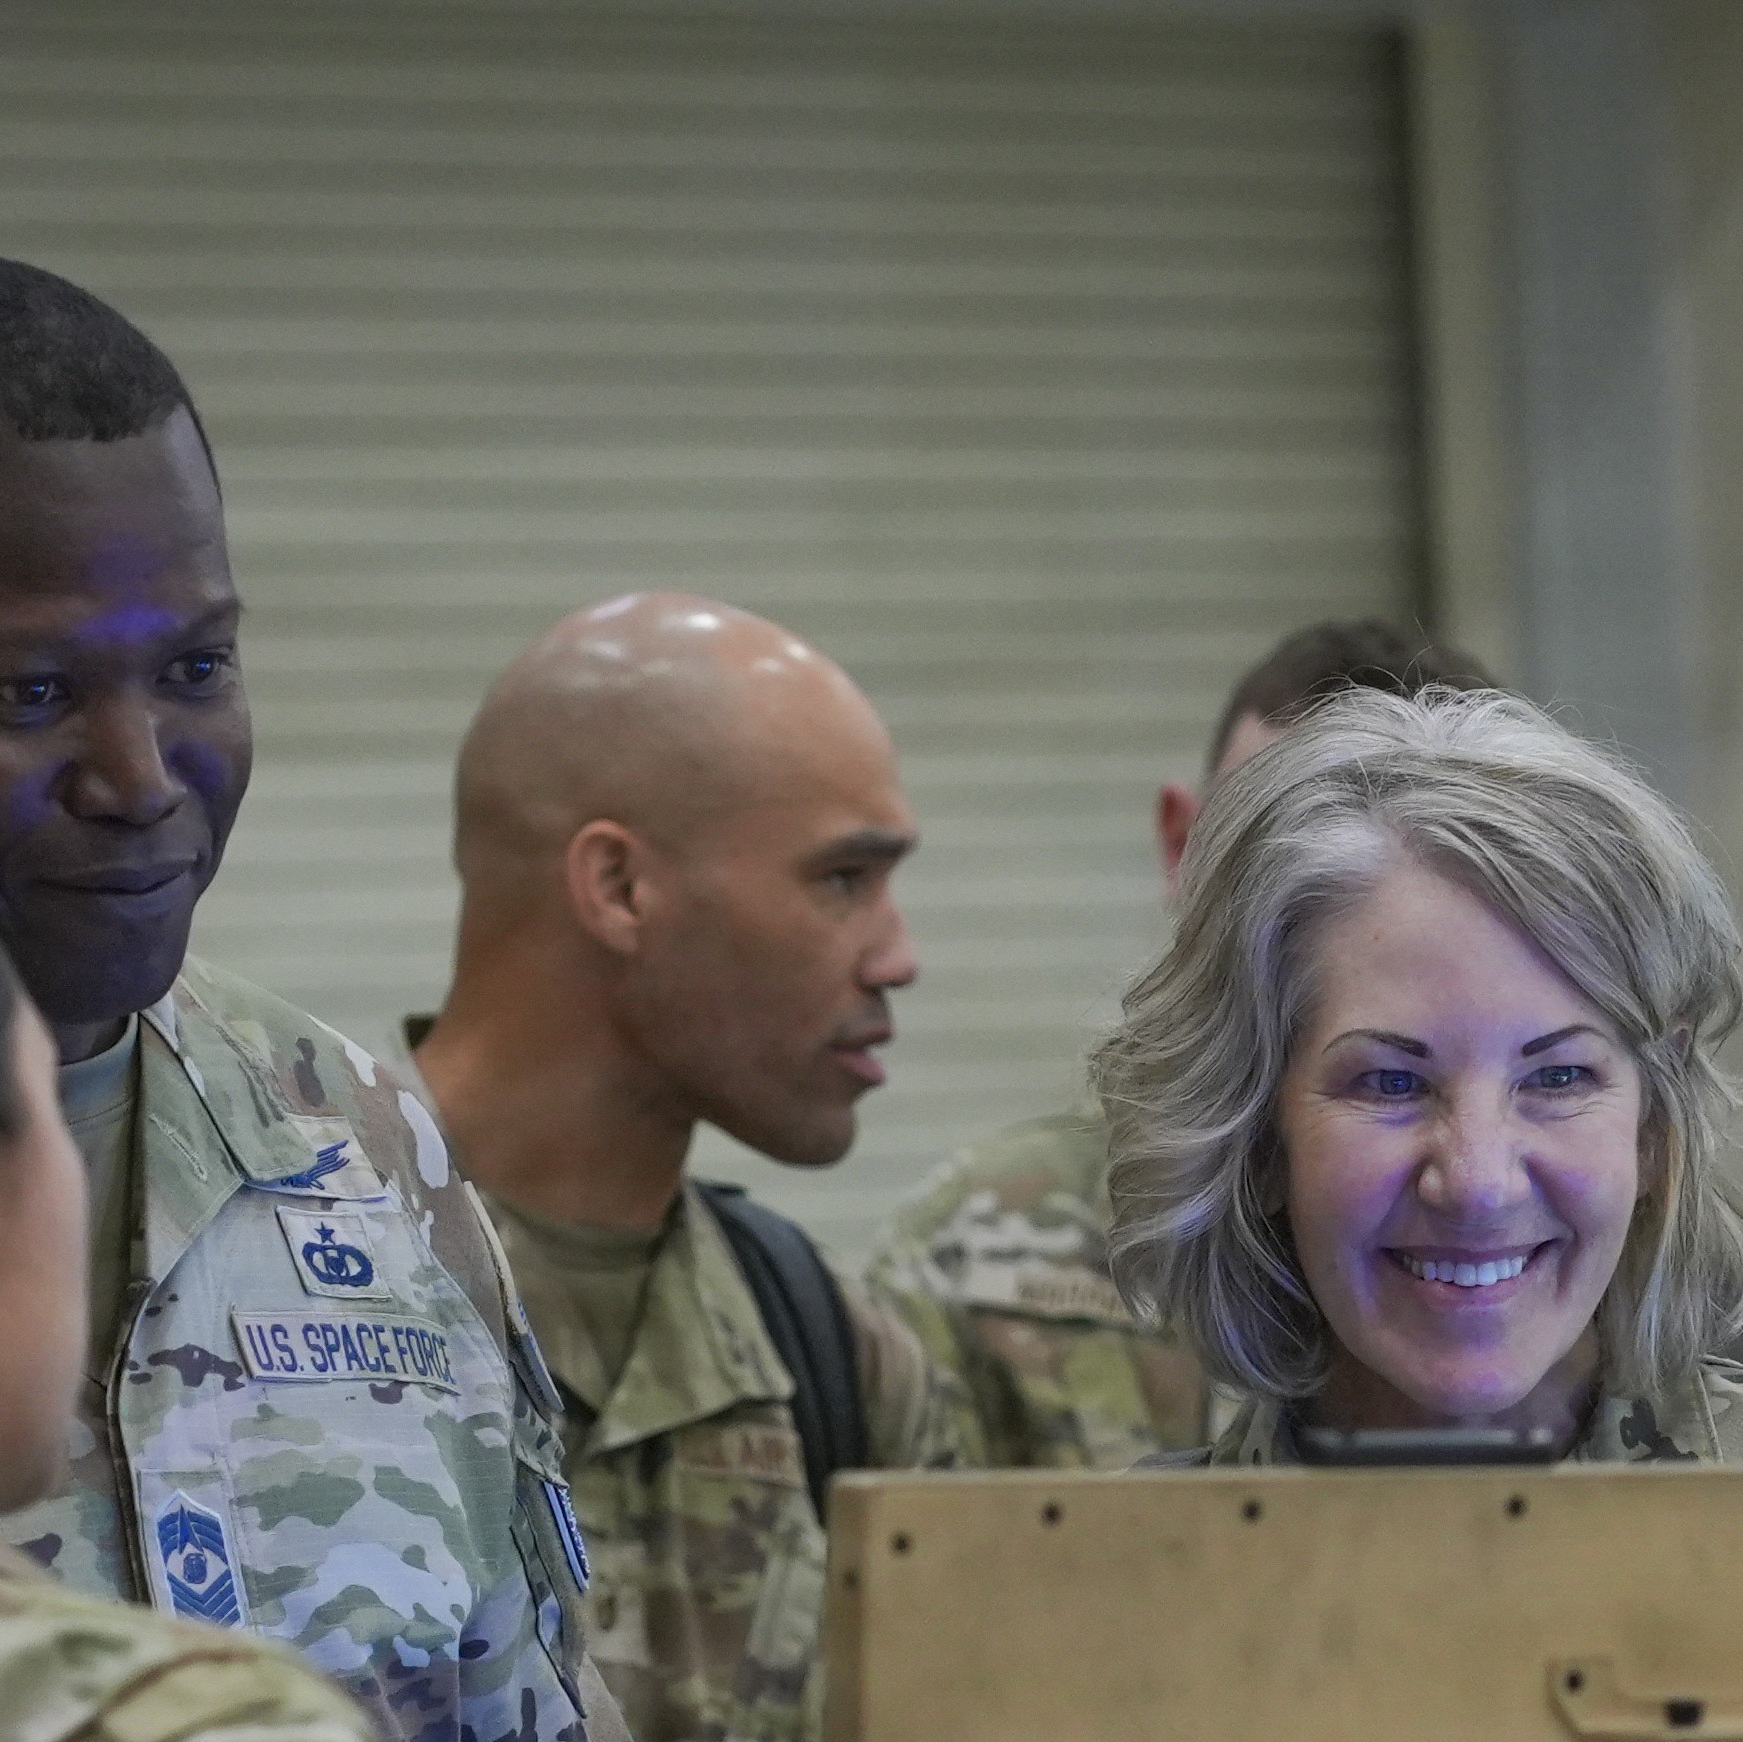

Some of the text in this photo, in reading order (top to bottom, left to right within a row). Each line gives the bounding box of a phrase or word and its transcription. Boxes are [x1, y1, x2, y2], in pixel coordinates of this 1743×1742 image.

[245, 1322, 457, 1385] U.S. SPACE FORCE
